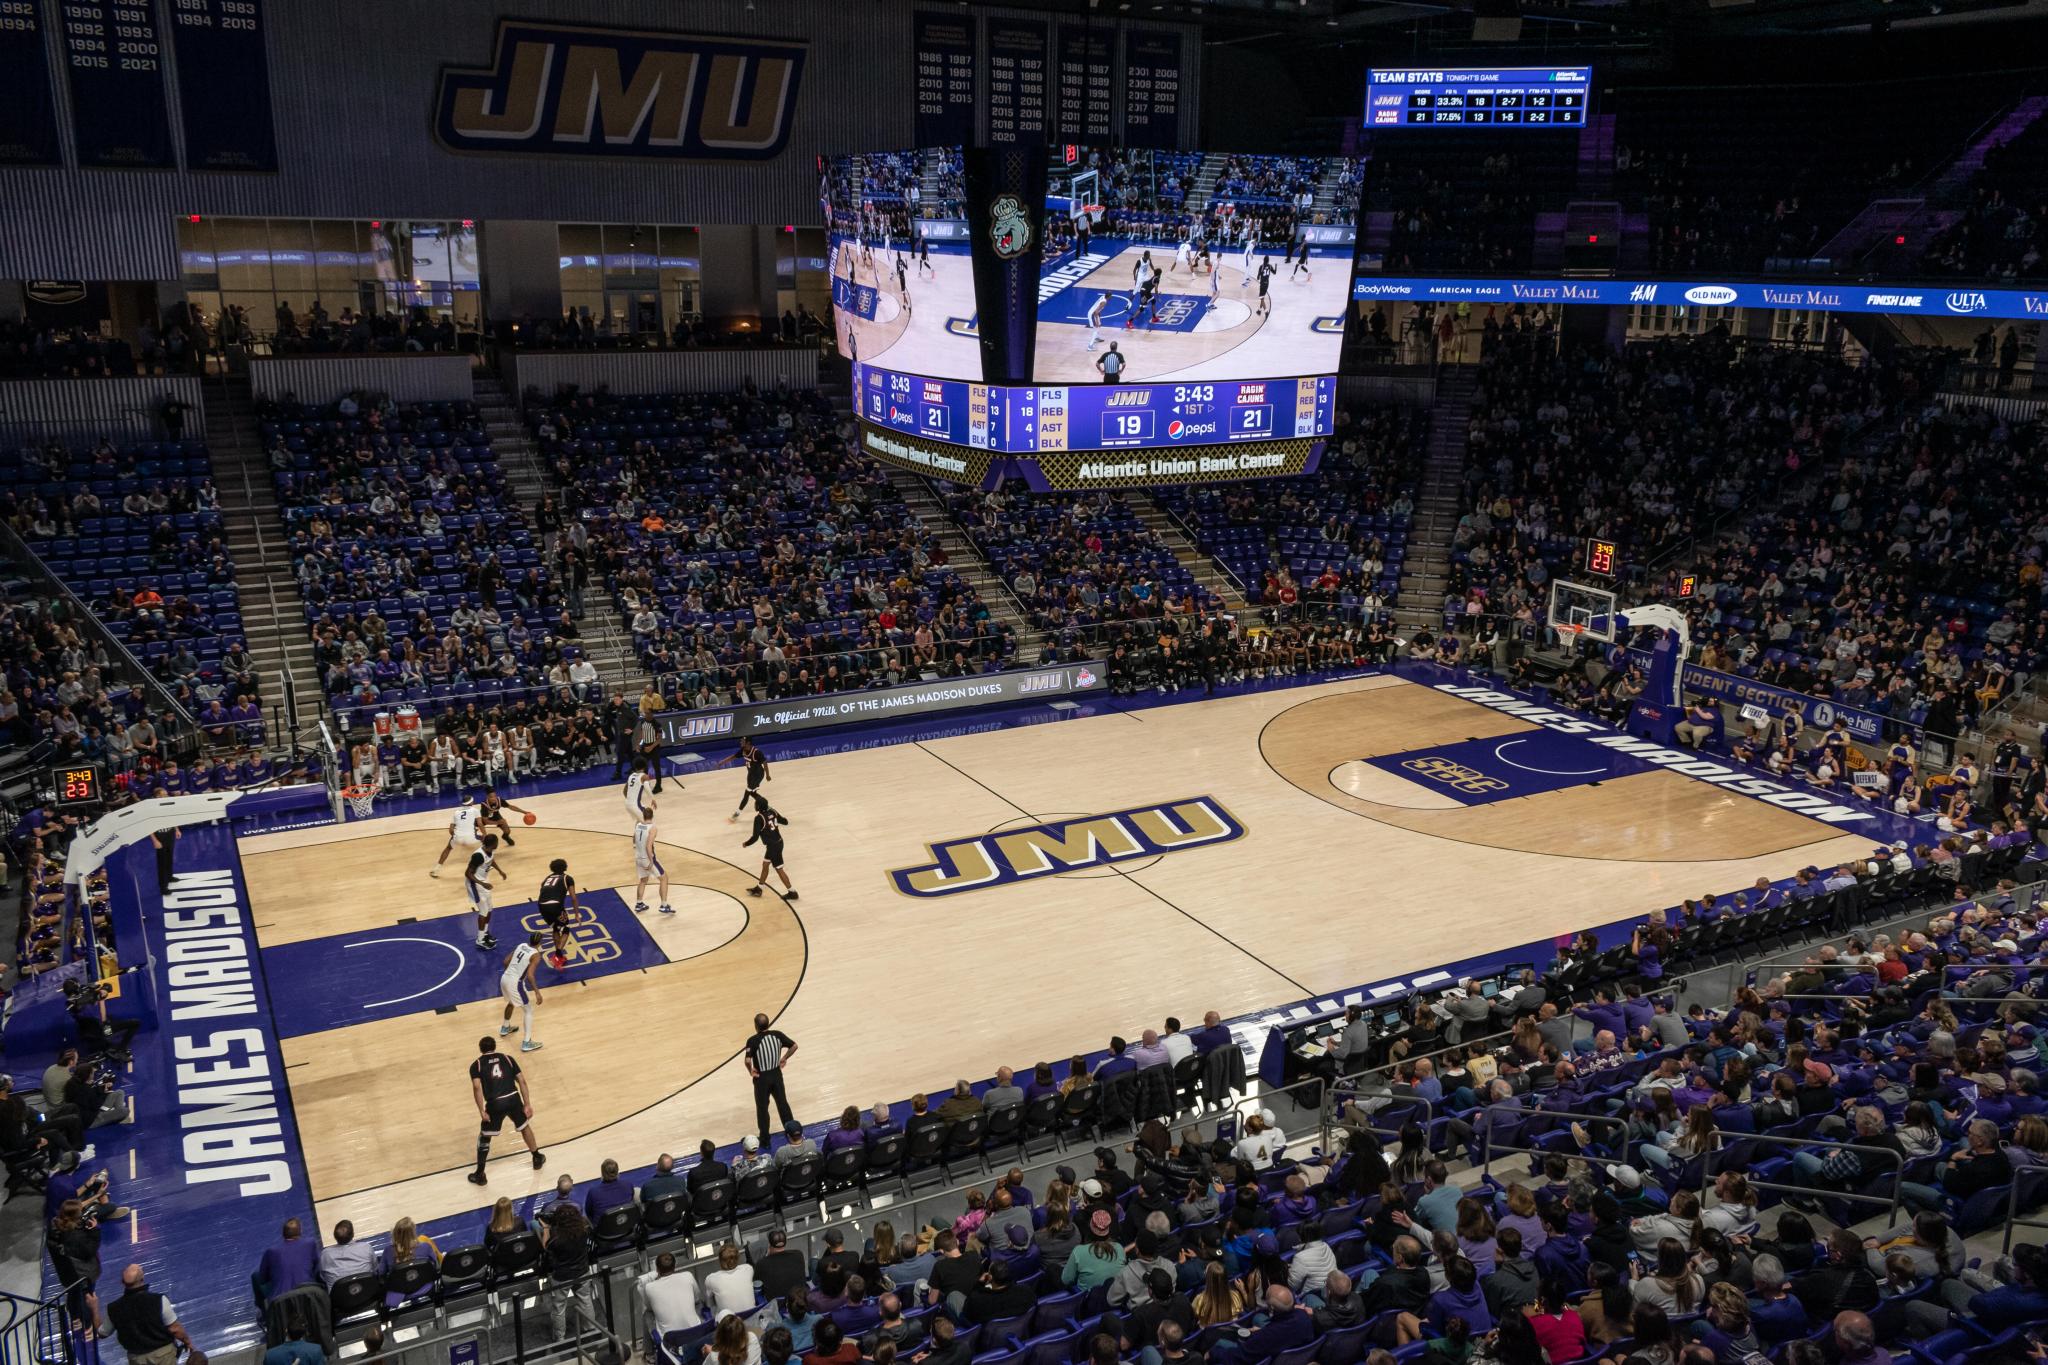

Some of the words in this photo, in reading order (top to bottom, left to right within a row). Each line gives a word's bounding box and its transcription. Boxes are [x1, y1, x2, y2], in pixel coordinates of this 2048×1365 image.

[176, 0, 208, 10] 1981
[220, 1, 256, 14] 1983
[64, 6, 102, 20] 1990
[112, 10, 146, 23] 1991
[176, 14, 212, 26] 1994
[221, 17, 256, 30] 2013
[66, 23, 104, 36] 1992
[115, 26, 152, 38] 1993
[69, 39, 107, 52] 1994
[118, 42, 158, 55] 2000
[71, 55, 109, 68] 2015
[120, 58, 156, 70] 2021
[950, 55, 971, 65] 1987
[992, 57, 1014, 67] 1986
[1020, 60, 1042, 69] 1987
[1373, 73, 1405, 83] TEAM
[1408, 73, 1443, 82] STATS
[919, 79, 942, 88] 2010
[950, 81, 970, 90] 2011
[992, 82, 1012, 92] 1991
[443, 28, 801, 155] JMU
[1129, 91, 1149, 100] 2012
[992, 94, 1012, 104] 2011
[1020, 97, 1042, 106] 2014
[1374, 95, 1403, 106] JMU
[1417, 97, 1426, 106] 19
[1437, 97, 1462, 106] 33.3%
[1502, 98, 1516, 106] 2-7
[1533, 98, 1545, 106] 1-2
[1089, 101, 1109, 111] 2010
[992, 107, 1014, 117] 2015
[1416, 113, 1425, 121] 21
[1437, 113, 1461, 121] 37.5%
[1474, 113, 1484, 121] 13
[1502, 113, 1514, 121] 1-5
[1530, 113, 1545, 121] 2-2
[1564, 113, 1571, 121] 5
[992, 132, 1016, 141] 2020
[1511, 284, 1558, 298] VALLEY
[1562, 285, 1600, 299] MALL
[1630, 284, 1658, 300] H&M
[1691, 291, 1708, 299] OLD
[1762, 289, 1804, 303] VALLEY
[1806, 291, 1841, 305] MALL
[1867, 294, 1900, 306] FINISH
[1900, 296, 1923, 307] LINE
[1952, 293, 1986, 307] ULTA
[891, 375, 910, 393] 3:43
[1301, 381, 1314, 390] FLS
[1319, 381, 1325, 389] 4
[972, 388, 986, 397] FLS
[991, 390, 996, 399] 4
[1026, 391, 1033, 400] 3
[1041, 391, 1061, 400] FLS
[1174, 386, 1214, 402] 3:43
[873, 395, 881, 412] 19
[1106, 390, 1151, 407] JMU
[1237, 395, 1265, 404] CAJUNS
[1299, 396, 1313, 405] REB
[1318, 395, 1327, 404] 13
[972, 404, 986, 414] REB
[991, 406, 999, 415] 13
[1021, 407, 1033, 416] 18
[1041, 408, 1063, 416] REB
[1185, 404, 1204, 414] 1ST
[1318, 410, 1323, 418] 7
[898, 412, 913, 425] pepsi
[929, 408, 941, 427] 21
[1243, 410, 1261, 428] 21
[1298, 411, 1313, 420] AST
[972, 421, 986, 430] AST
[991, 422, 996, 431] 7
[1025, 424, 1033, 432] 4
[1041, 424, 1062, 432] AST
[1117, 416, 1141, 435] 19
[1185, 421, 1216, 436] pepsi
[1298, 425, 1311, 433] BLK
[1317, 424, 1322, 433] 0
[972, 435, 986, 445] BLK
[991, 438, 996, 447] 0
[1028, 440, 1033, 448] 1
[1041, 440, 1062, 448] BLK
[1079, 460, 1147, 479] Atlantic
[1151, 458, 1197, 476] Union
[1200, 455, 1238, 471] Bank
[1239, 452, 1286, 470] Center
[1597, 543, 1613, 555] 3:43
[1593, 553, 1610, 571] 23
[1681, 585, 1690, 595] 23
[1735, 684, 1808, 714] SECTION
[680, 713, 733, 738] JMU
[753, 715, 771, 727] The
[774, 710, 810, 724] Official
[813, 707, 837, 718] Milk
[841, 703, 856, 714] OF
[858, 700, 879, 711] THE
[881, 695, 915, 708] JAMES
[917, 689, 967, 703] MADISON
[968, 684, 1002, 696] DUKES
[1019, 672, 1063, 693] JMU
[1834, 711, 1854, 726] the
[1855, 716, 1877, 732] hills
[1434, 684, 1608, 733] JAMES
[1586, 736, 1876, 821] MADISON
[66, 769, 92, 783] 3:43
[1855, 774, 1878, 784] DEFENSE
[630, 778, 635, 787] 5
[66, 783, 88, 798] 23
[460, 811, 467, 820] 2
[890, 796, 1244, 897] JMU
[162, 869, 259, 1020] MADISON
[516, 952, 524, 964] 4
[492, 1063, 502, 1079] 4
[174, 1028, 293, 1198] JAMES
[1256, 1145, 1267, 1161] 4
